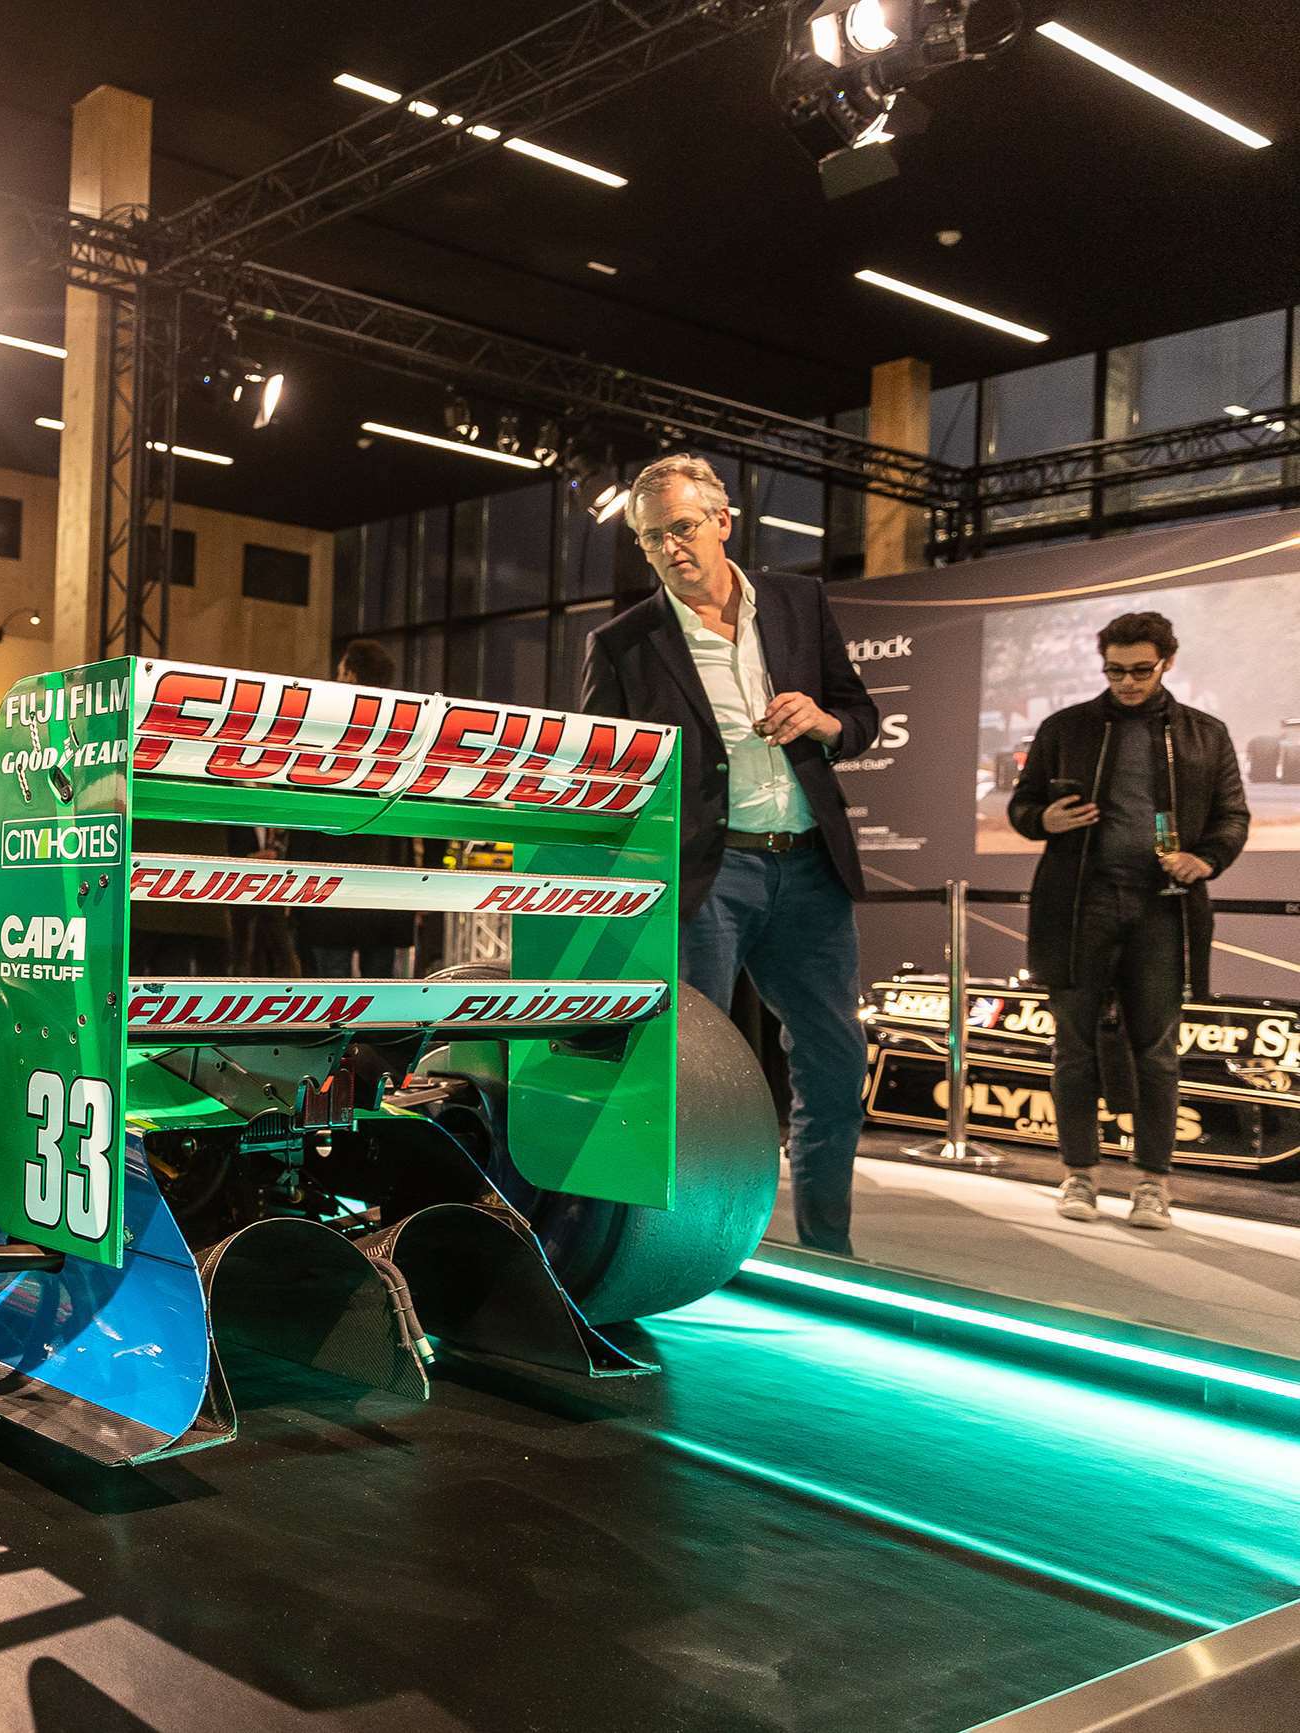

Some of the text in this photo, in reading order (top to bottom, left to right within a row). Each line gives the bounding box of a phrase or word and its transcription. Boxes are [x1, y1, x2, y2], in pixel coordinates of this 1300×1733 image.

[134, 670, 662, 809] FUJIFILM
[130, 867, 344, 904] FUJIFILM
[474, 884, 652, 916] FUJIFILM
[1, 915, 87, 961] CAPA
[1, 962, 85, 982] DYE STUFF
[128, 995, 375, 1025] FUJIFILM
[443, 995, 652, 1022] FUJIFILM
[1176, 1022, 1249, 1056] yer
[24, 1068, 114, 1244] 33
